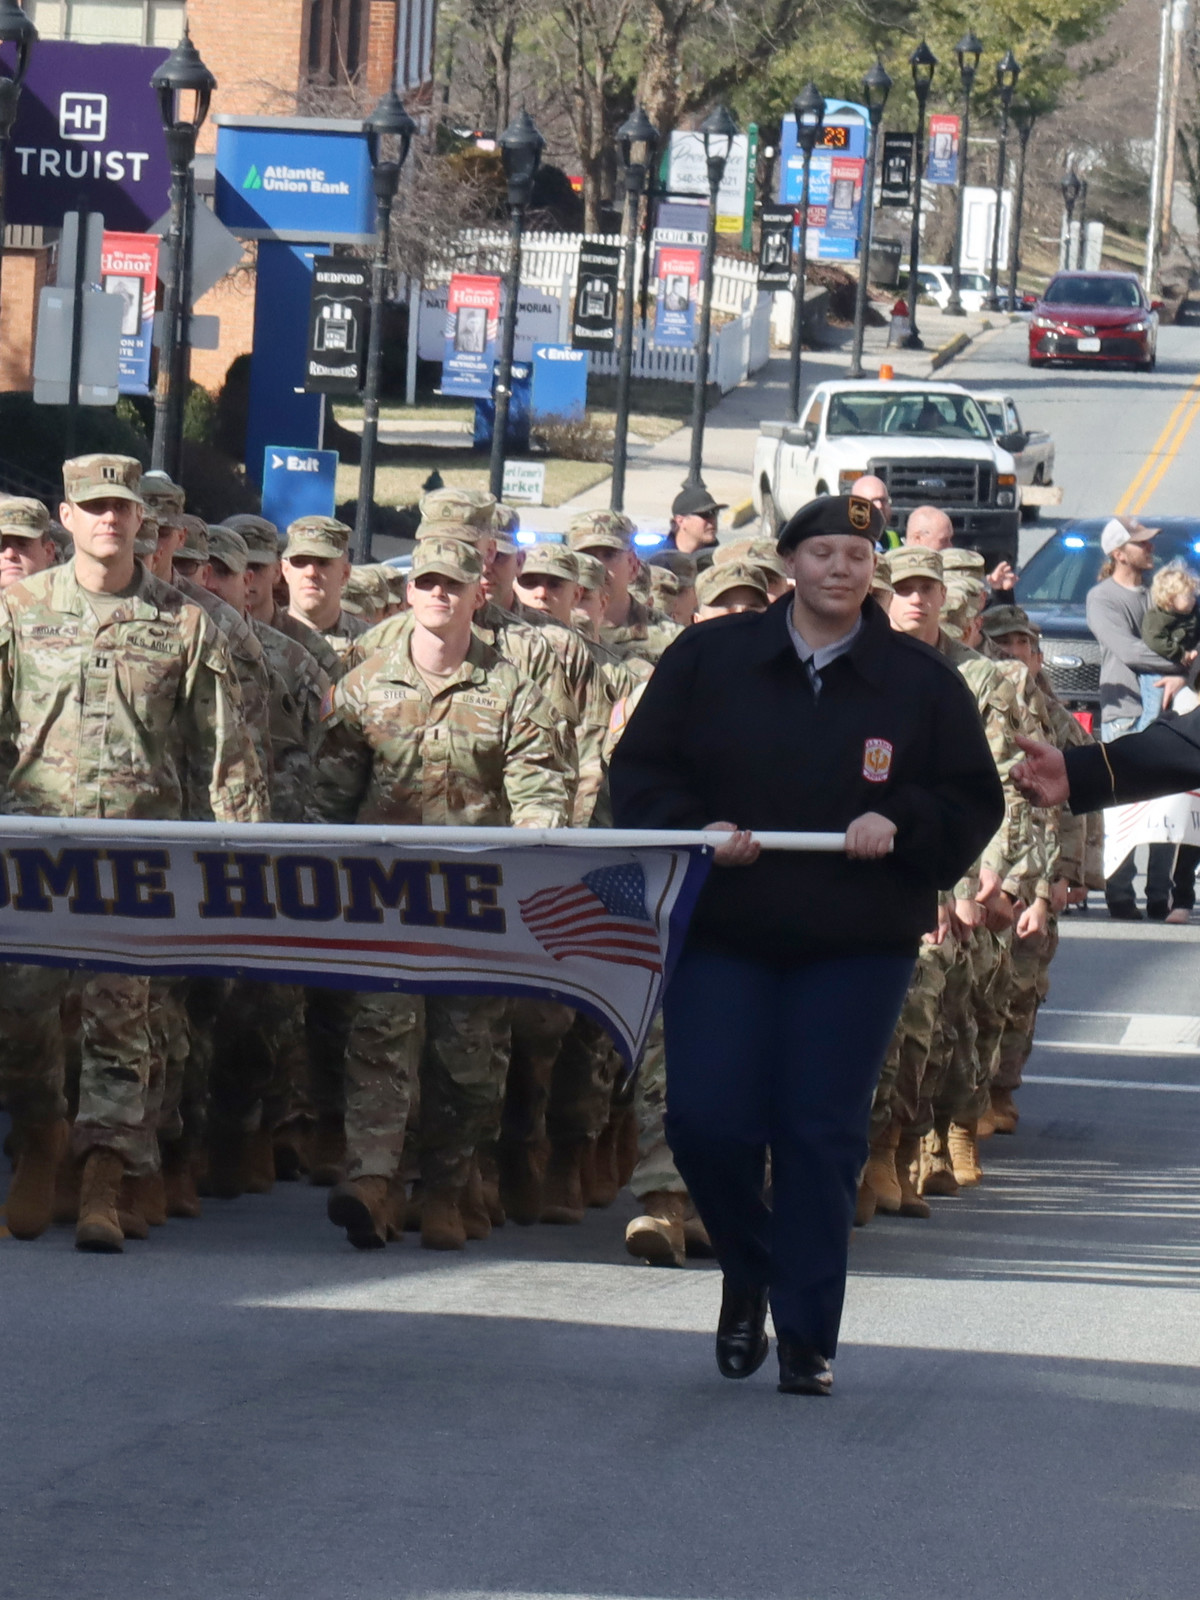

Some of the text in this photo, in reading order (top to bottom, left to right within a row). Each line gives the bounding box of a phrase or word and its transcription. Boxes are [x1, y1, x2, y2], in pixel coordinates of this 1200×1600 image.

[15, 147, 149, 181] TRUIST
[264, 165, 325, 181] Atlantic
[263, 178, 350, 195] Union Bank
[316, 272, 364, 285] BEDFORD
[453, 290, 496, 306] Honor
[548, 348, 584, 361] Enter
[309, 361, 358, 378] REMEMBERS
[286, 455, 320, 472] Exit
[150, 640, 174, 651] ARMY
[476, 697, 498, 708] ARMY
[193, 851, 506, 934] HOME
